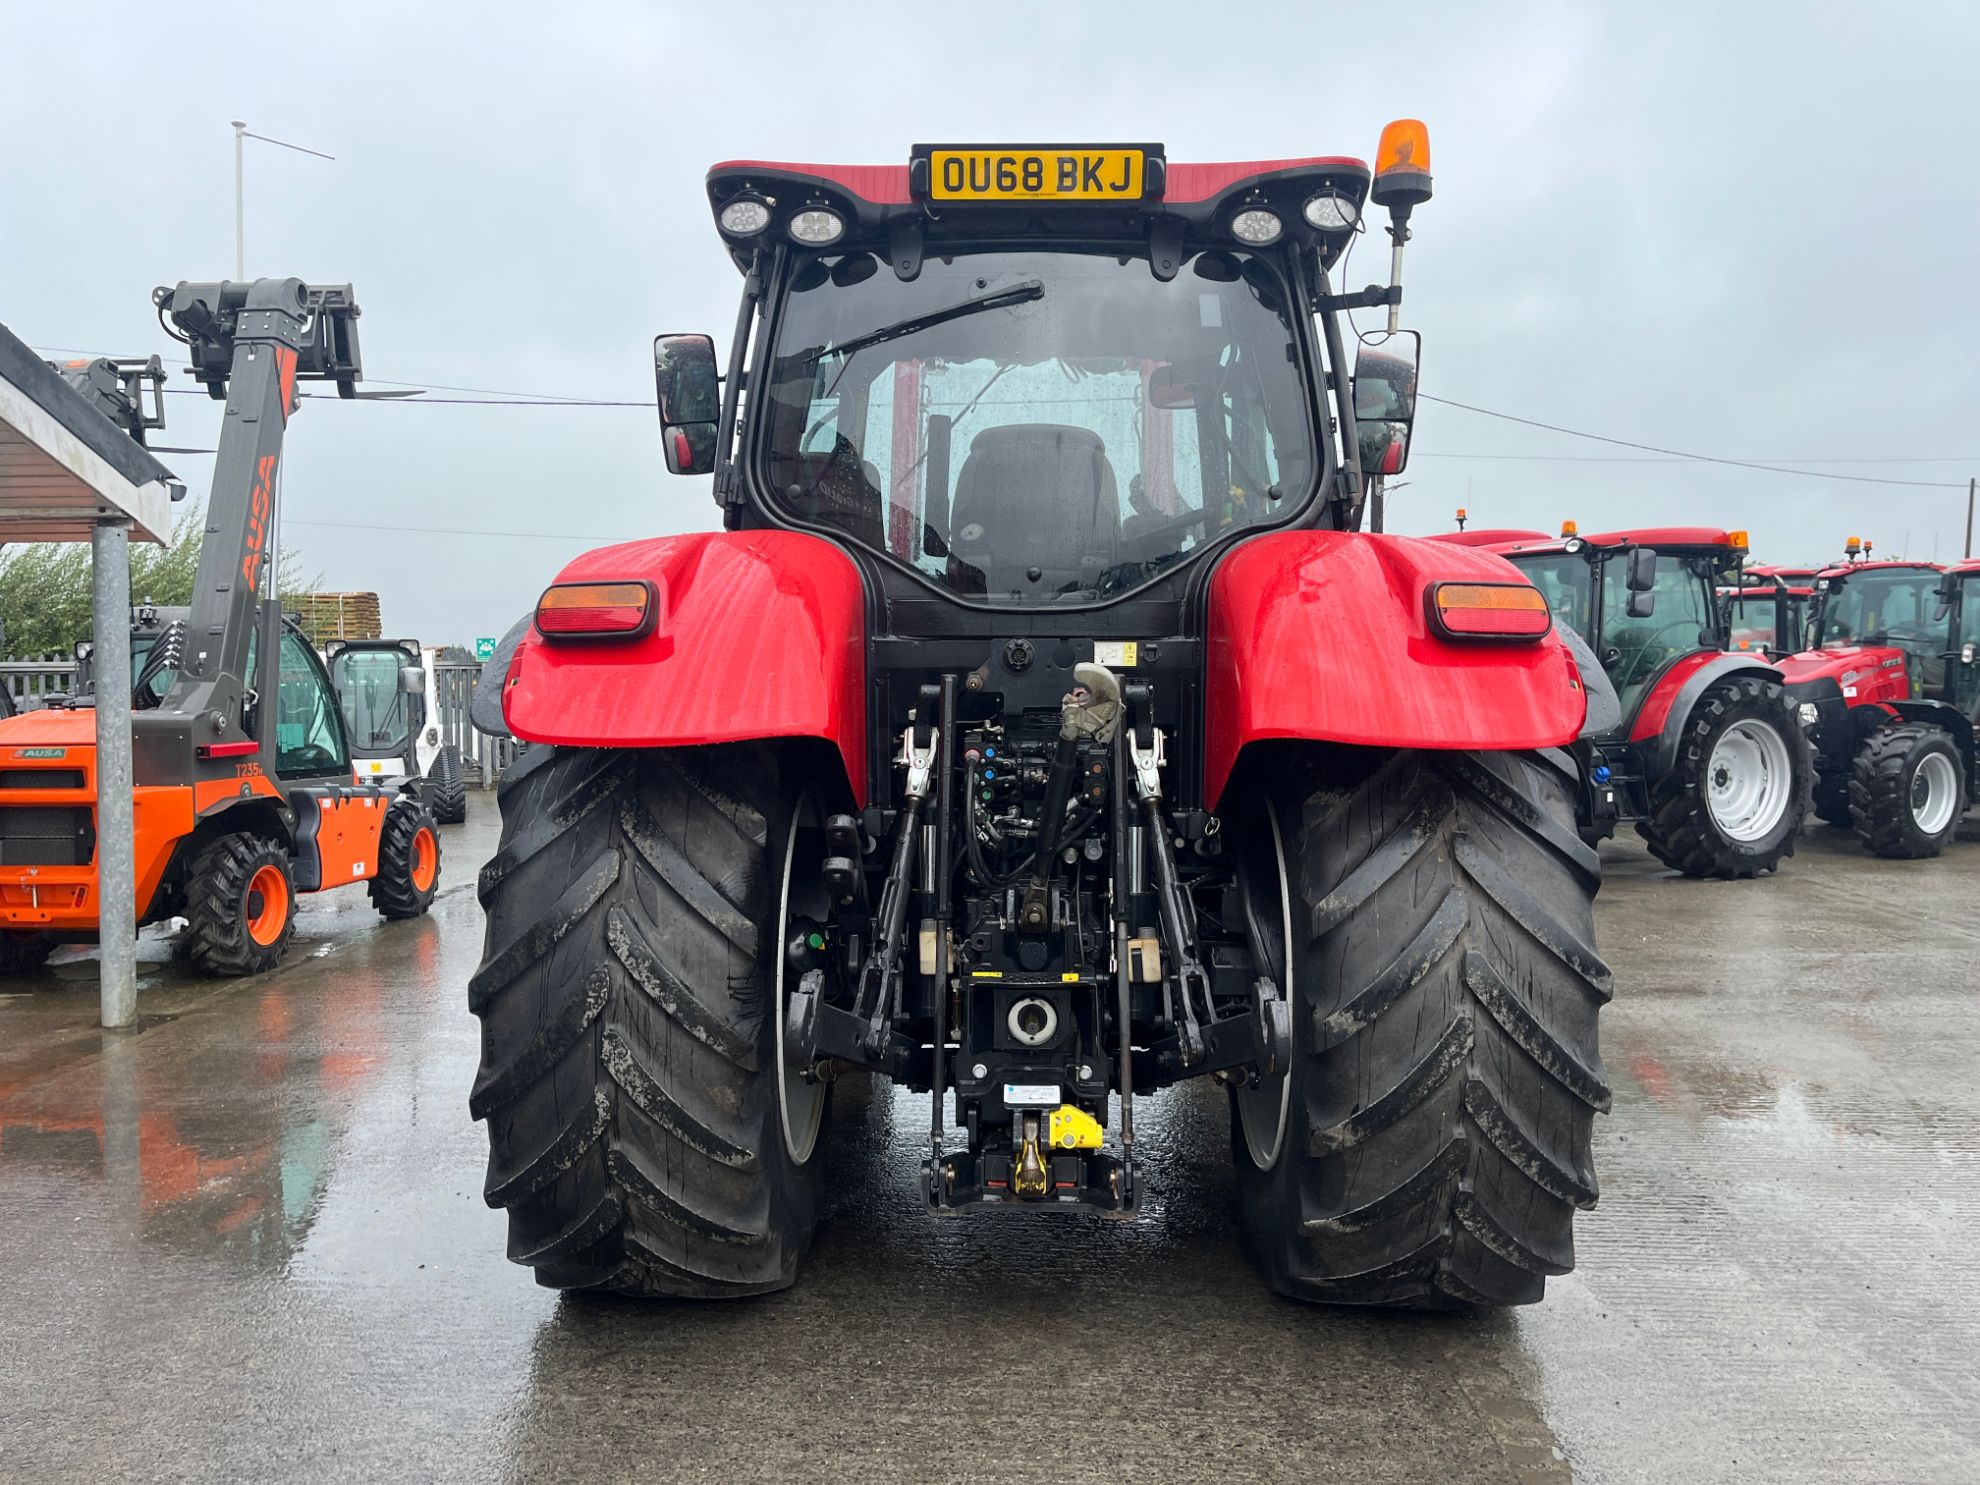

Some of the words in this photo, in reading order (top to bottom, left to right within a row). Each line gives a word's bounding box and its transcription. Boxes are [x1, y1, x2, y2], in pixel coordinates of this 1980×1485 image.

[943, 157, 1044, 192] OU68
[1056, 156, 1131, 192] BKJ
[243, 455, 275, 592] AUSA
[24, 749, 64, 757] AUSA
